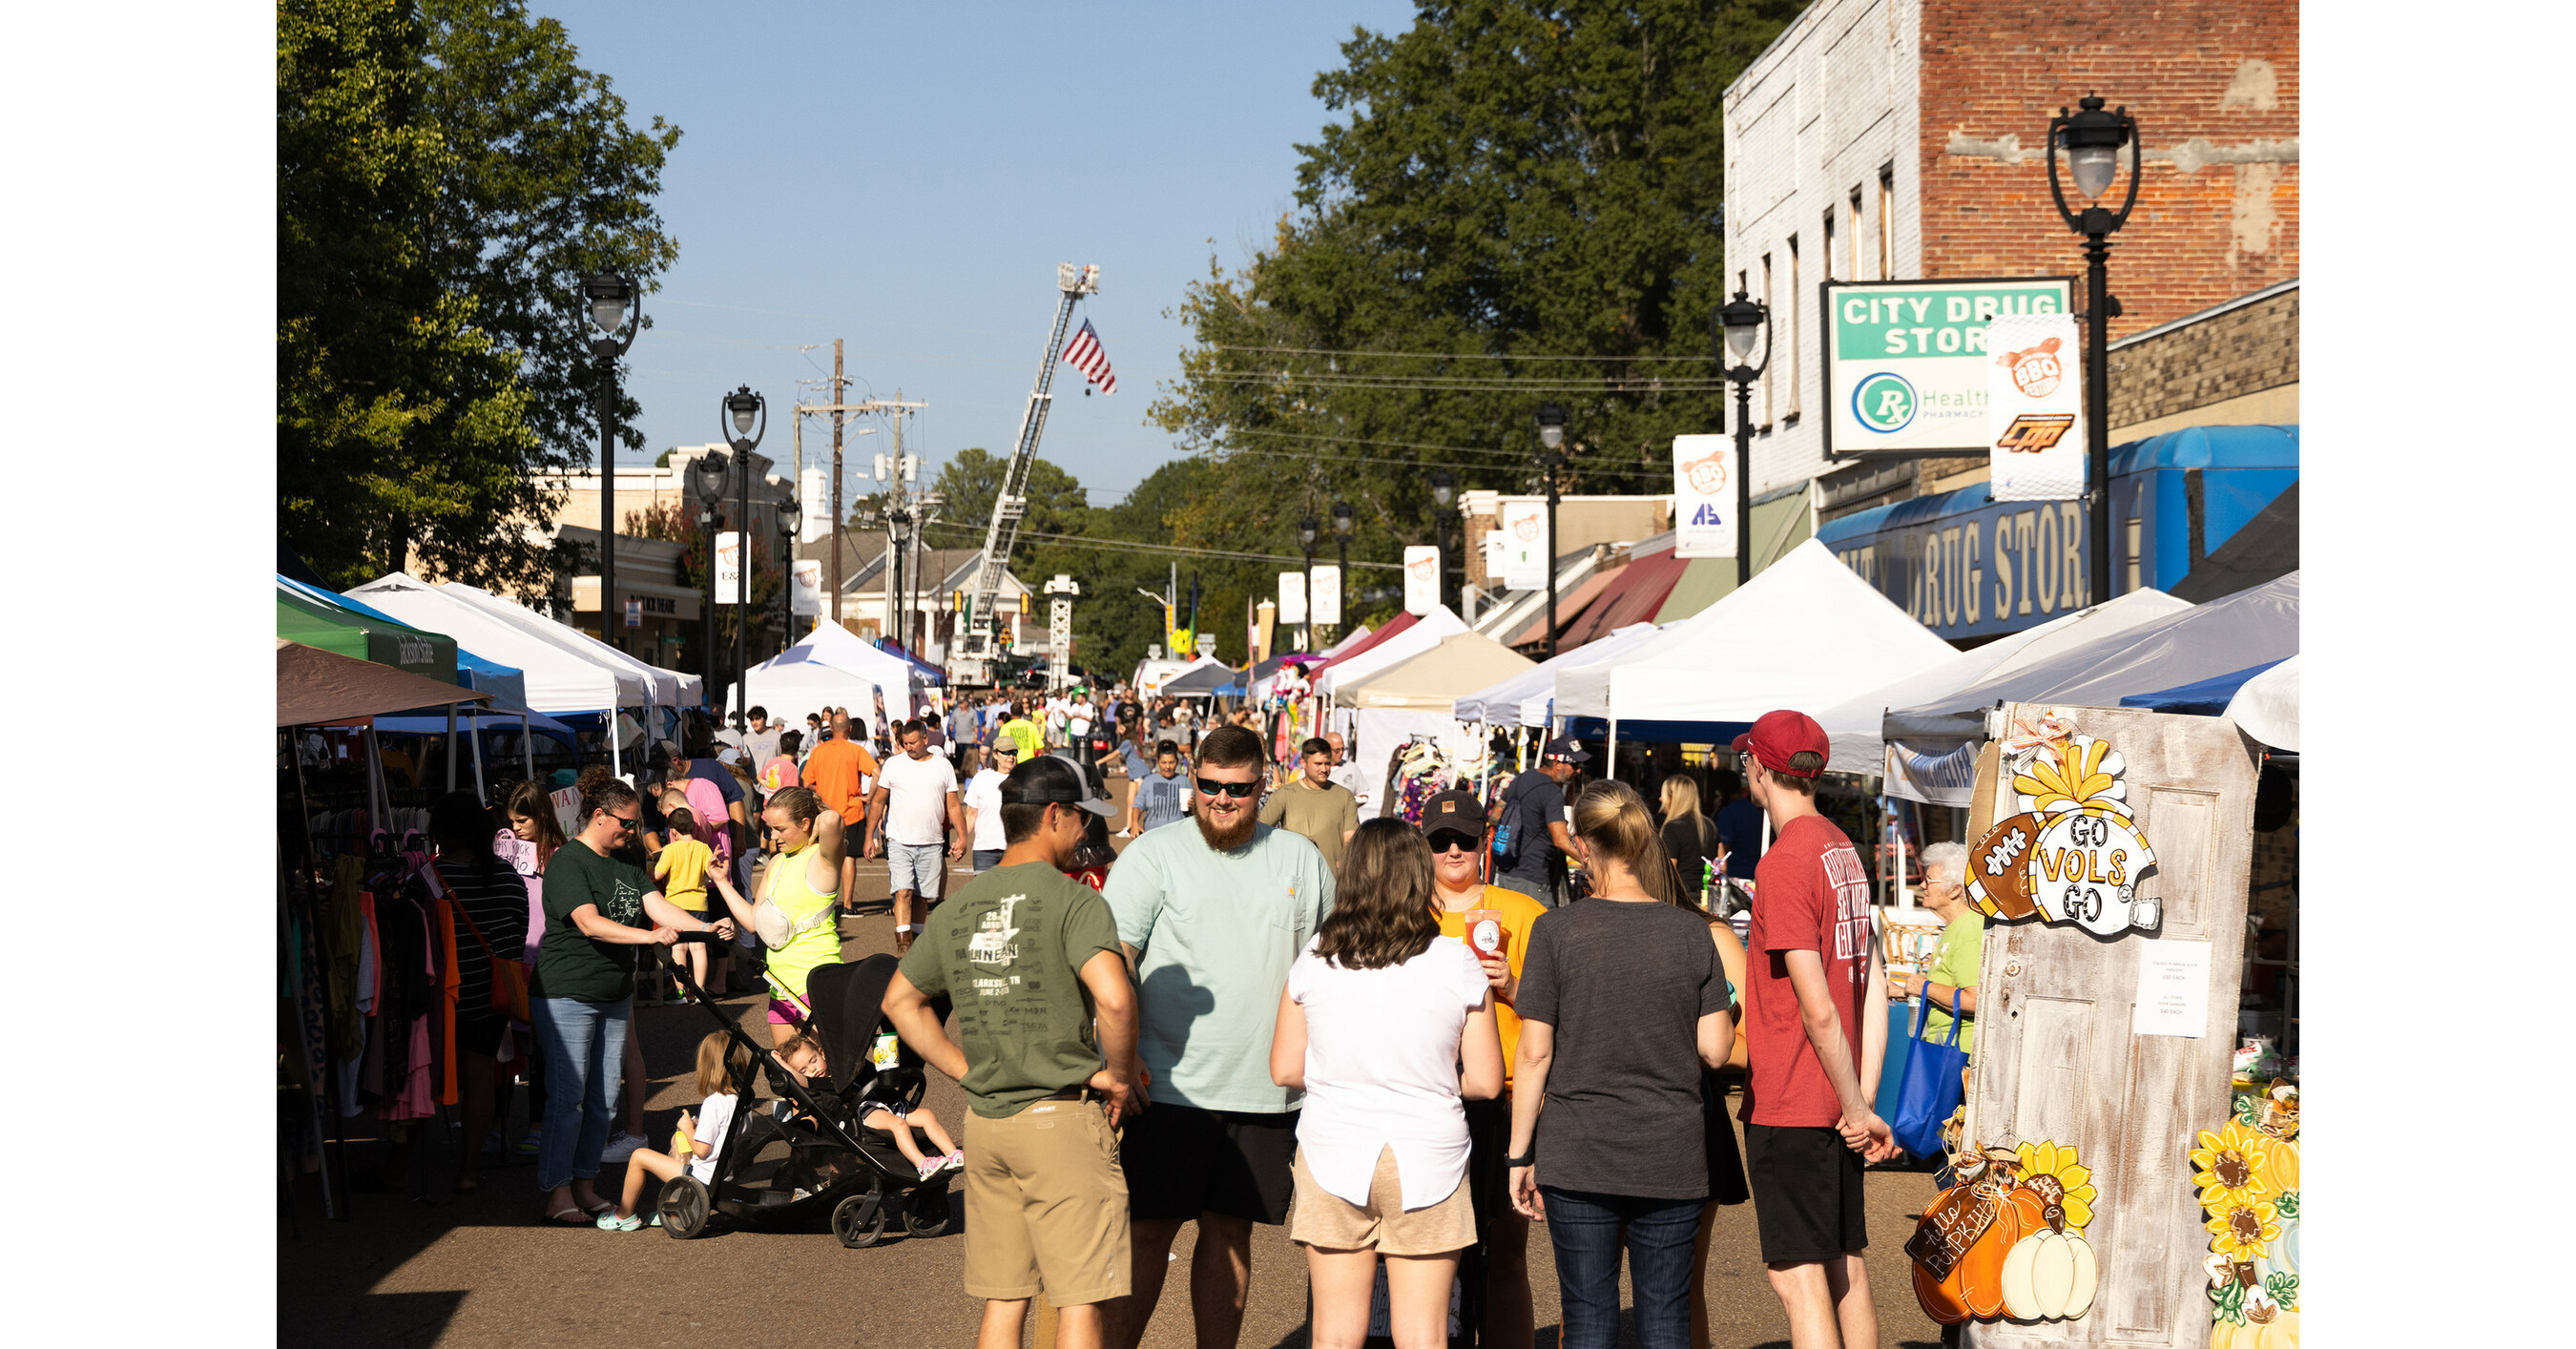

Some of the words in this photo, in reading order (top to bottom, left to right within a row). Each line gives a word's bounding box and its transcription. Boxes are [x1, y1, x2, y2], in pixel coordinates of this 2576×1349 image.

[1843, 297, 1932, 324] CITY
[1946, 294, 2056, 322] DRUG
[1884, 326, 1988, 354] STOR
[2014, 357, 2059, 387] BBQ
[722, 571, 739, 581] E&
[1904, 520, 1983, 628] DRUG
[1994, 501, 2091, 621] STOR
[2070, 815, 2109, 848] GO
[2039, 846, 2128, 887] VOLS
[2063, 883, 2102, 924] GO
[1009, 975, 1021, 985] TN
[1923, 1199, 1961, 1246] hello
